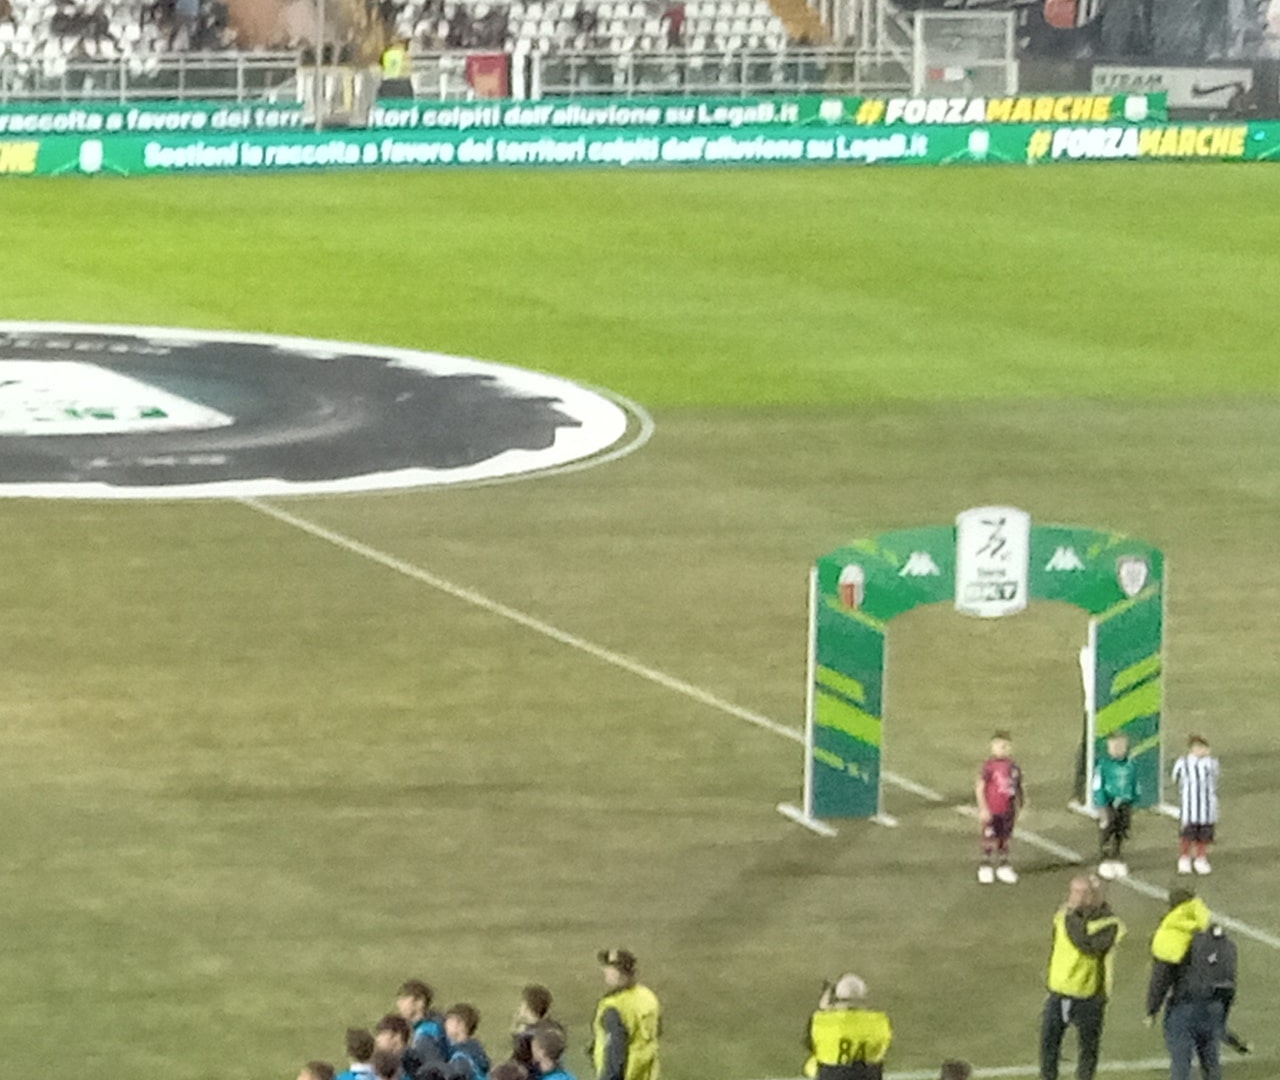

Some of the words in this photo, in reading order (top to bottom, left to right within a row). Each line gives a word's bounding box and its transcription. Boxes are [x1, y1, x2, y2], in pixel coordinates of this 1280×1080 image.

[105, 112, 123, 131] a
[127, 108, 207, 130] favore
[211, 107, 251, 129] dei
[422, 104, 500, 130] colpiti
[504, 103, 661, 127] dall'alluvione
[664, 104, 695, 124] su
[856, 96, 1112, 125] #FORZAMARCHE
[144, 141, 238, 167] Sostieni
[241, 141, 262, 165] la
[265, 140, 360, 165] raccolta
[362, 142, 379, 163] a
[381, 137, 454, 163] favore
[457, 137, 494, 162] dei
[497, 135, 585, 161] territori
[588, 136, 659, 165] colpiti
[806, 138, 834, 158] su
[1027, 126, 1247, 161] #FORZAMARCHE
